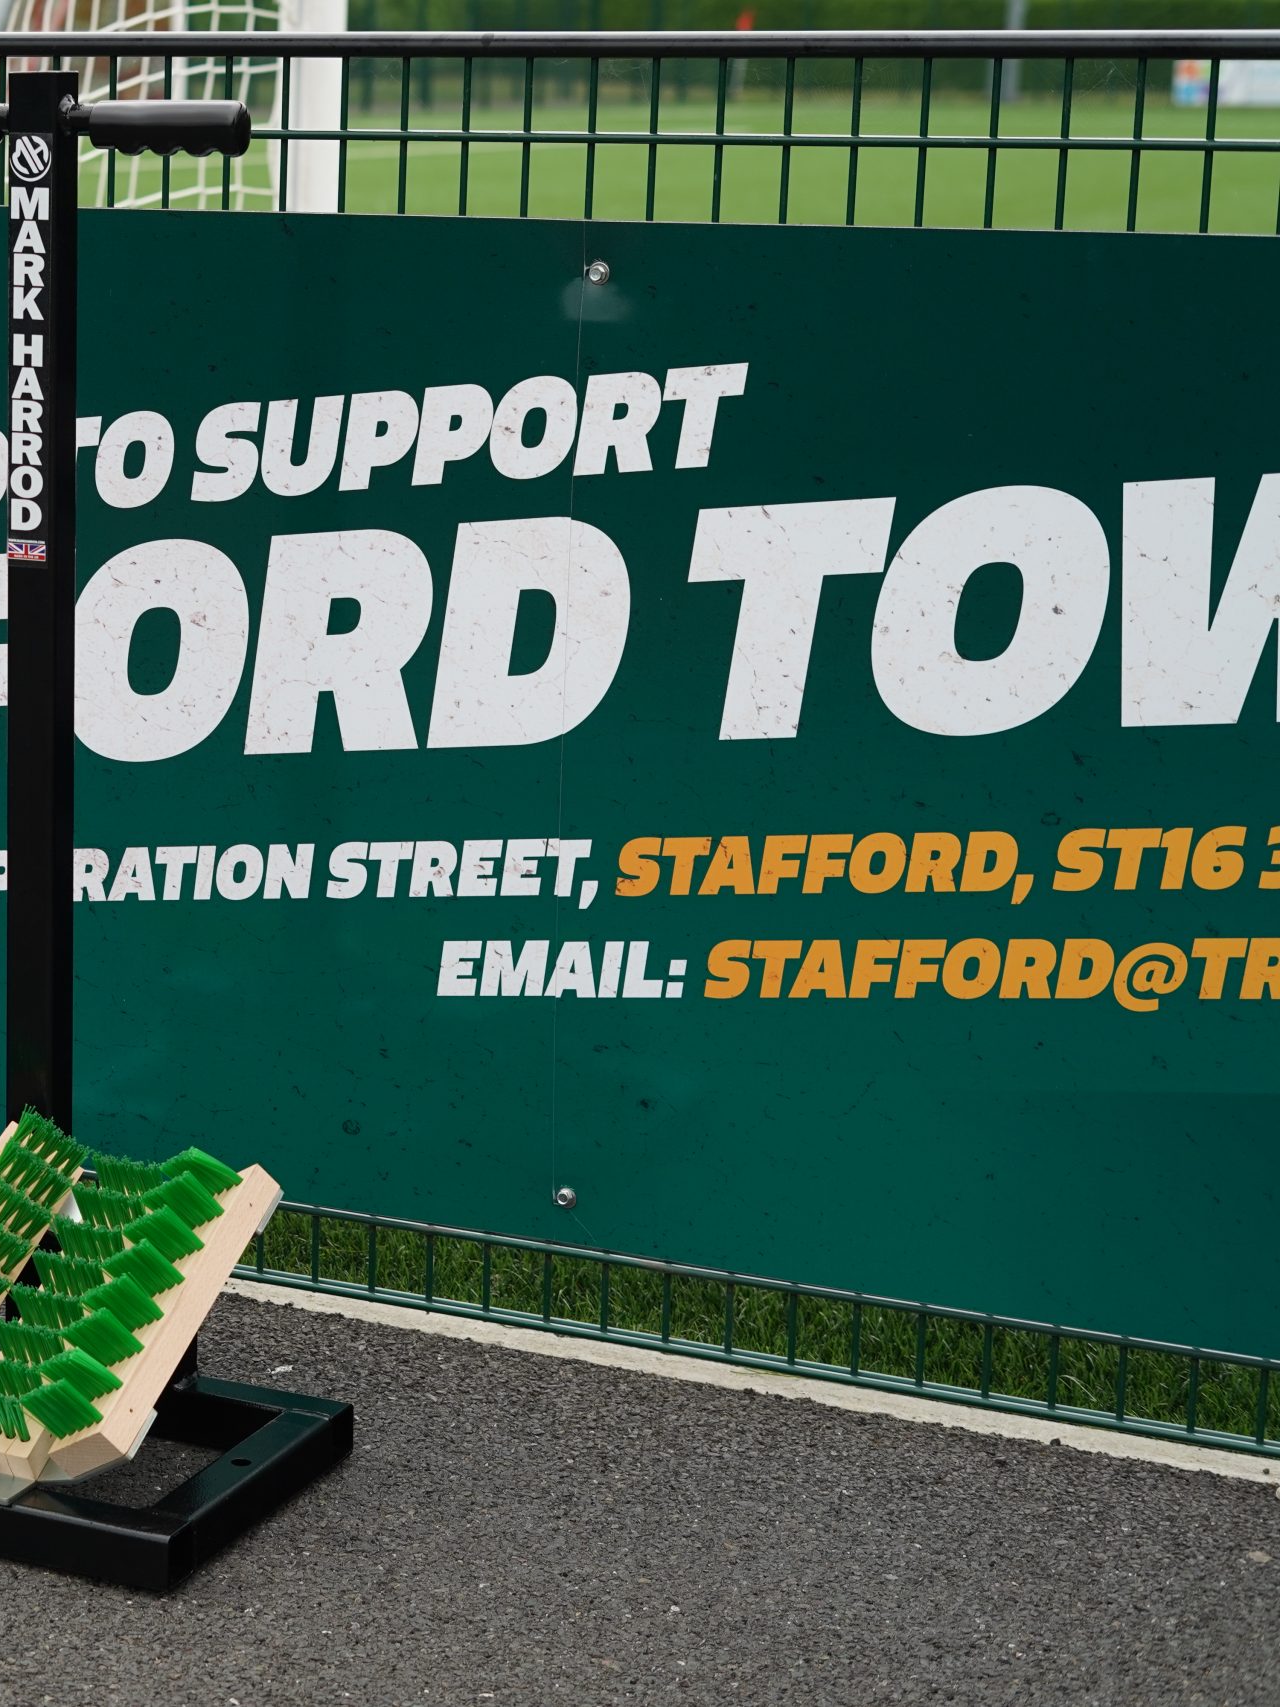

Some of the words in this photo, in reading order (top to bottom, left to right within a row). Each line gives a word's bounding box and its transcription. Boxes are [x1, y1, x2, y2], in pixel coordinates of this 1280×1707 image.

[11, 187, 49, 320] MARK
[11, 334, 44, 530] HARROD
[191, 363, 749, 502] SUPPORT
[326, 838, 598, 909] STREET,
[616, 831, 1033, 904] STAFFORD,
[1053, 826, 1246, 891] ST16
[437, 940, 687, 998] EMAIL:
[704, 938, 1280, 1011] STAFFORD@TR
